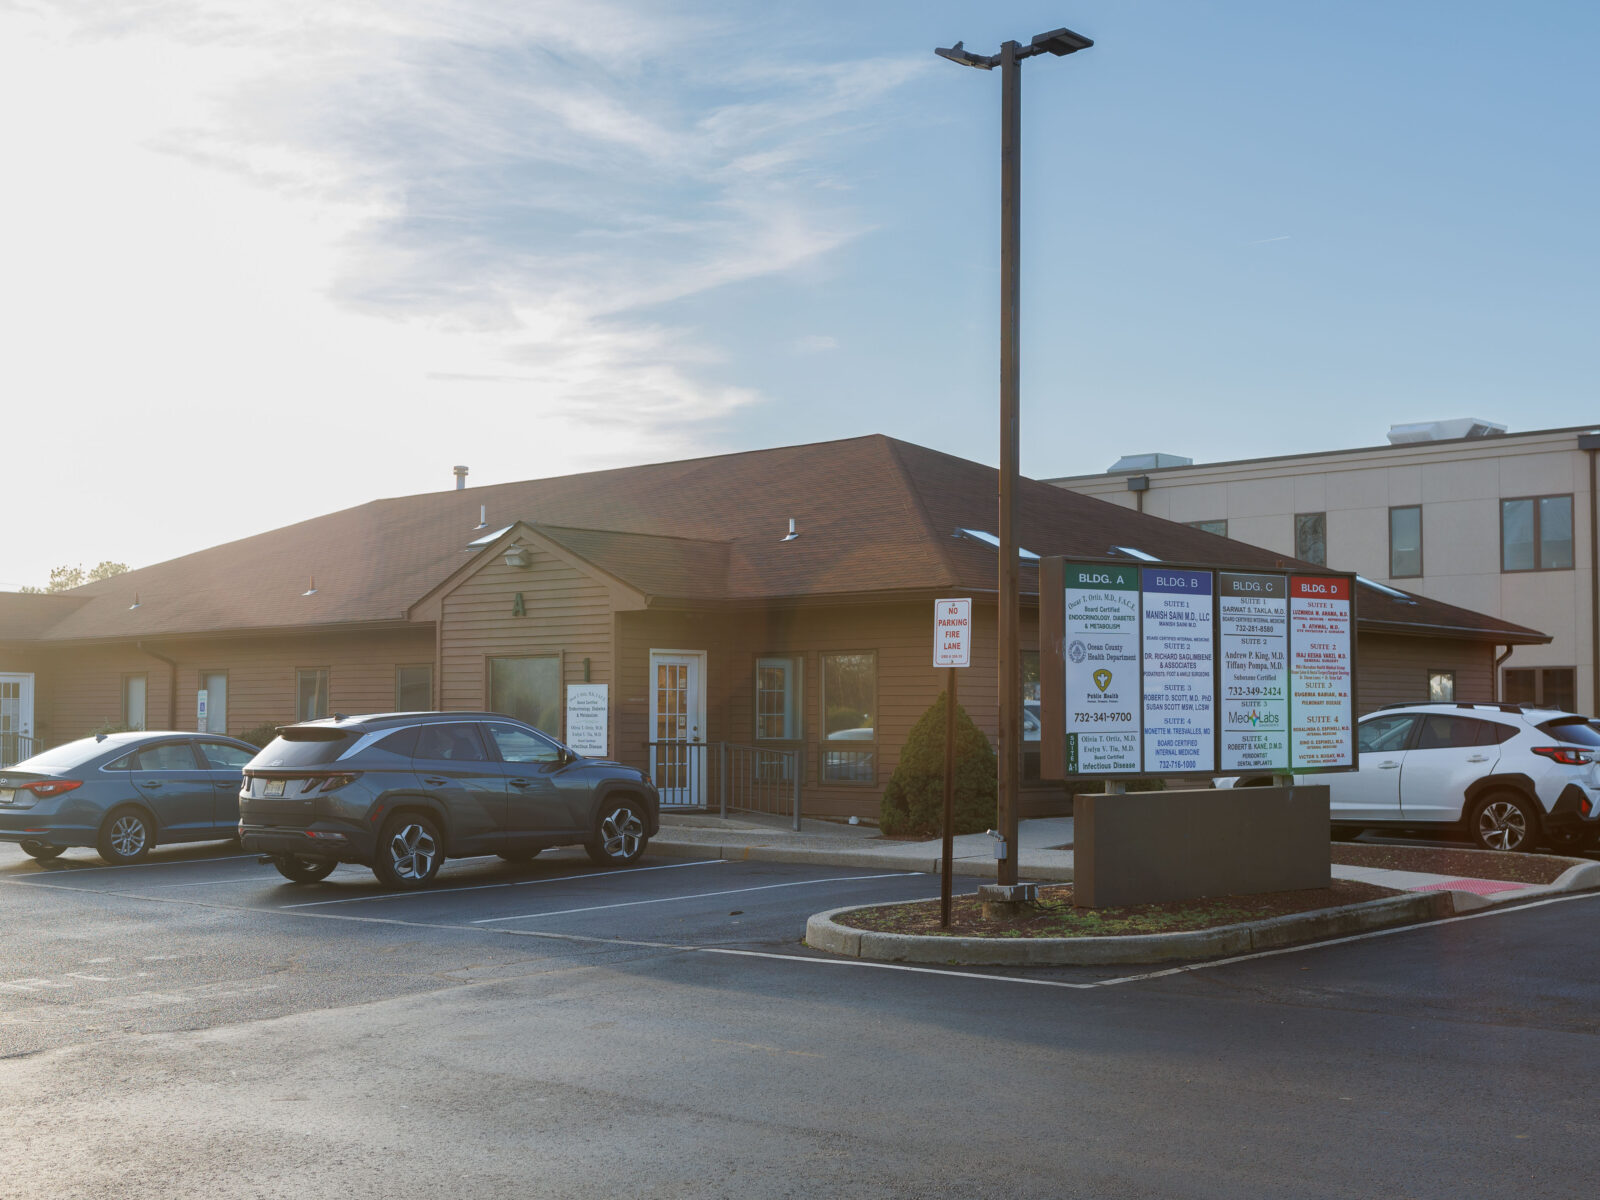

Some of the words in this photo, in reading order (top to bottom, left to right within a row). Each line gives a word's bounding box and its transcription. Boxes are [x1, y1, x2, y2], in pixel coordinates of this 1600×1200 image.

[1079, 573, 1112, 584] BLDG.
[1116, 576, 1124, 584] A
[1156, 577, 1188, 587] BLDG.
[1191, 579, 1198, 587] B
[1233, 581, 1262, 591] BLDG.
[1266, 583, 1272, 591] C
[1301, 584, 1327, 593] BLDG.
[1331, 585, 1337, 593] D
[512, 592, 526, 616] A
[1146, 610, 1167, 619] MANISH
[1169, 611, 1183, 620] SAINI
[1199, 613, 1210, 621] LLC
[1105, 644, 1123, 652] County
[1107, 654, 1136, 662] Department
[1255, 652, 1269, 661] King,
[1226, 661, 1246, 671] Tiffany
[1228, 687, 1281, 696] 732-349-2424
[1074, 712, 1132, 722] 732-341-9700
